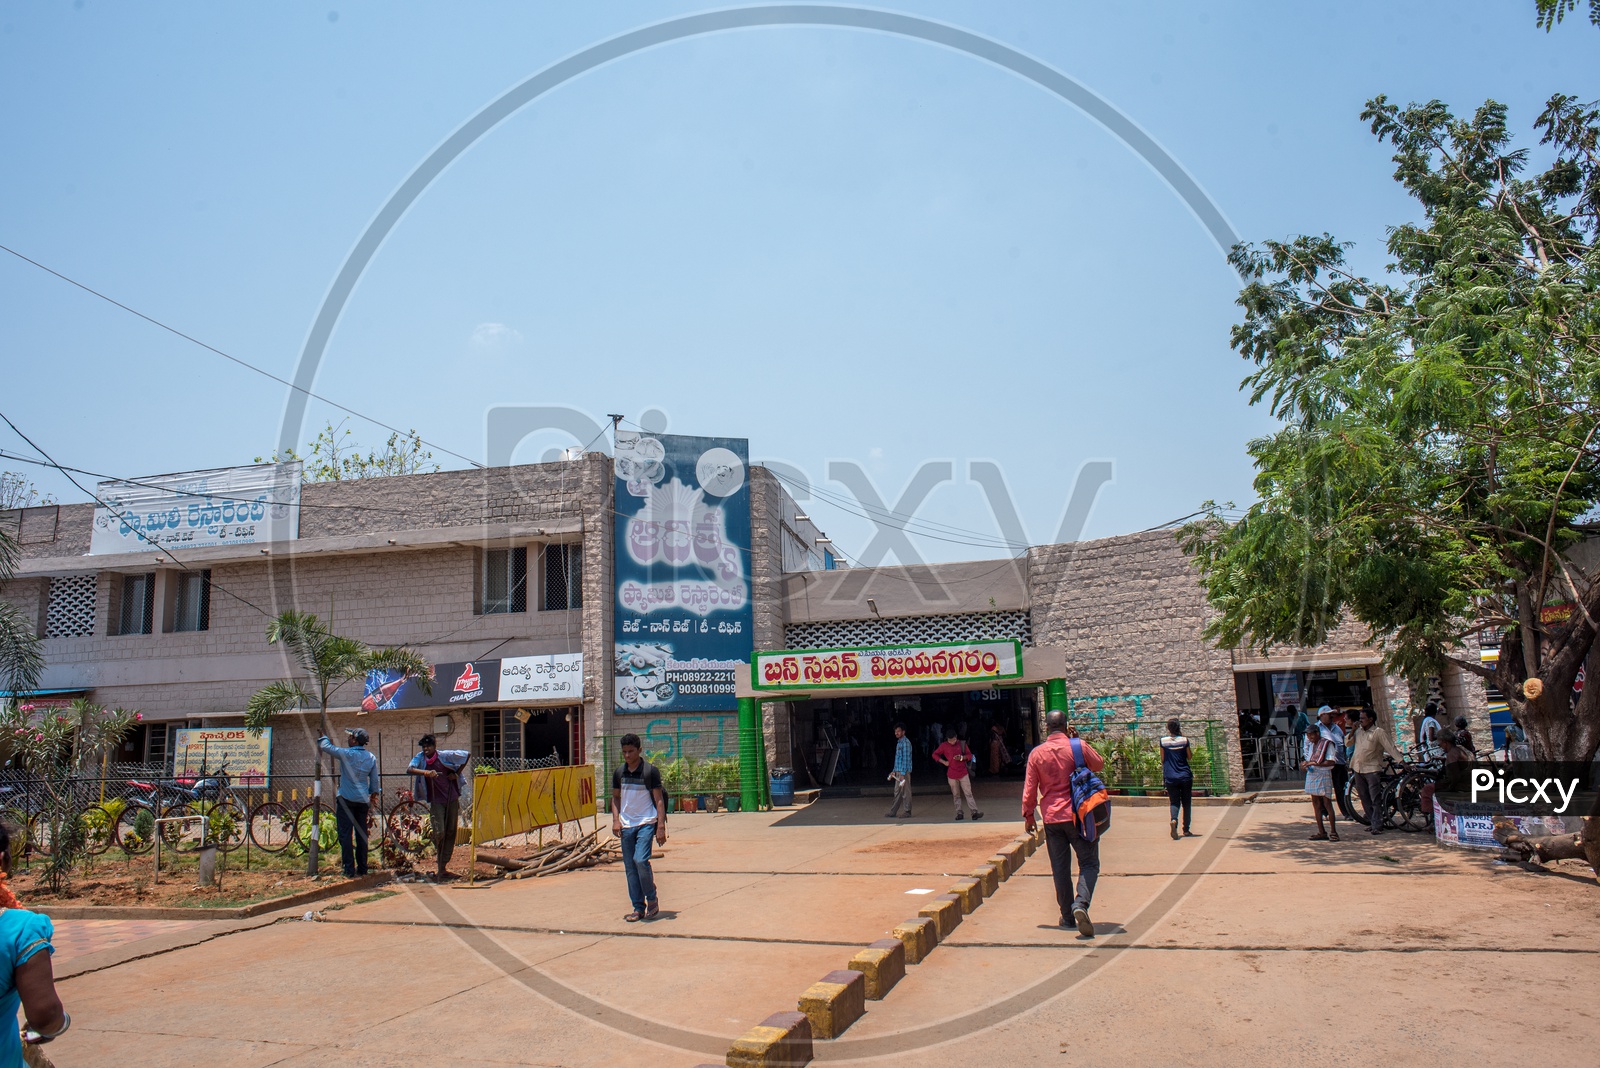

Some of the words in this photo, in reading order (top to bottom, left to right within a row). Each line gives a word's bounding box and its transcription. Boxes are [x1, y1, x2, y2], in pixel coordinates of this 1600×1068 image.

[623, 583, 675, 611] ఫ్యామిలీ
[680, 585, 743, 612] రెస్టారెంట్
[622, 619, 641, 632] వెజ్
[650, 619, 670, 633] నాన్
[672, 619, 691, 632] వెజ్
[502, 664, 532, 680] ఆదిత్య
[536, 660, 581, 679] రెస్టారెంట్
[764, 657, 799, 682] బస్
[803, 652, 858, 683] స్టేషన్
[871, 649, 997, 677] విజయనగరం
[449, 690, 483, 703] CHARGED
[679, 684, 735, 694] 9030810999
[982, 689, 1001, 700] SBI
[646, 715, 739, 759] SFI
[580, 777, 593, 805] IN
